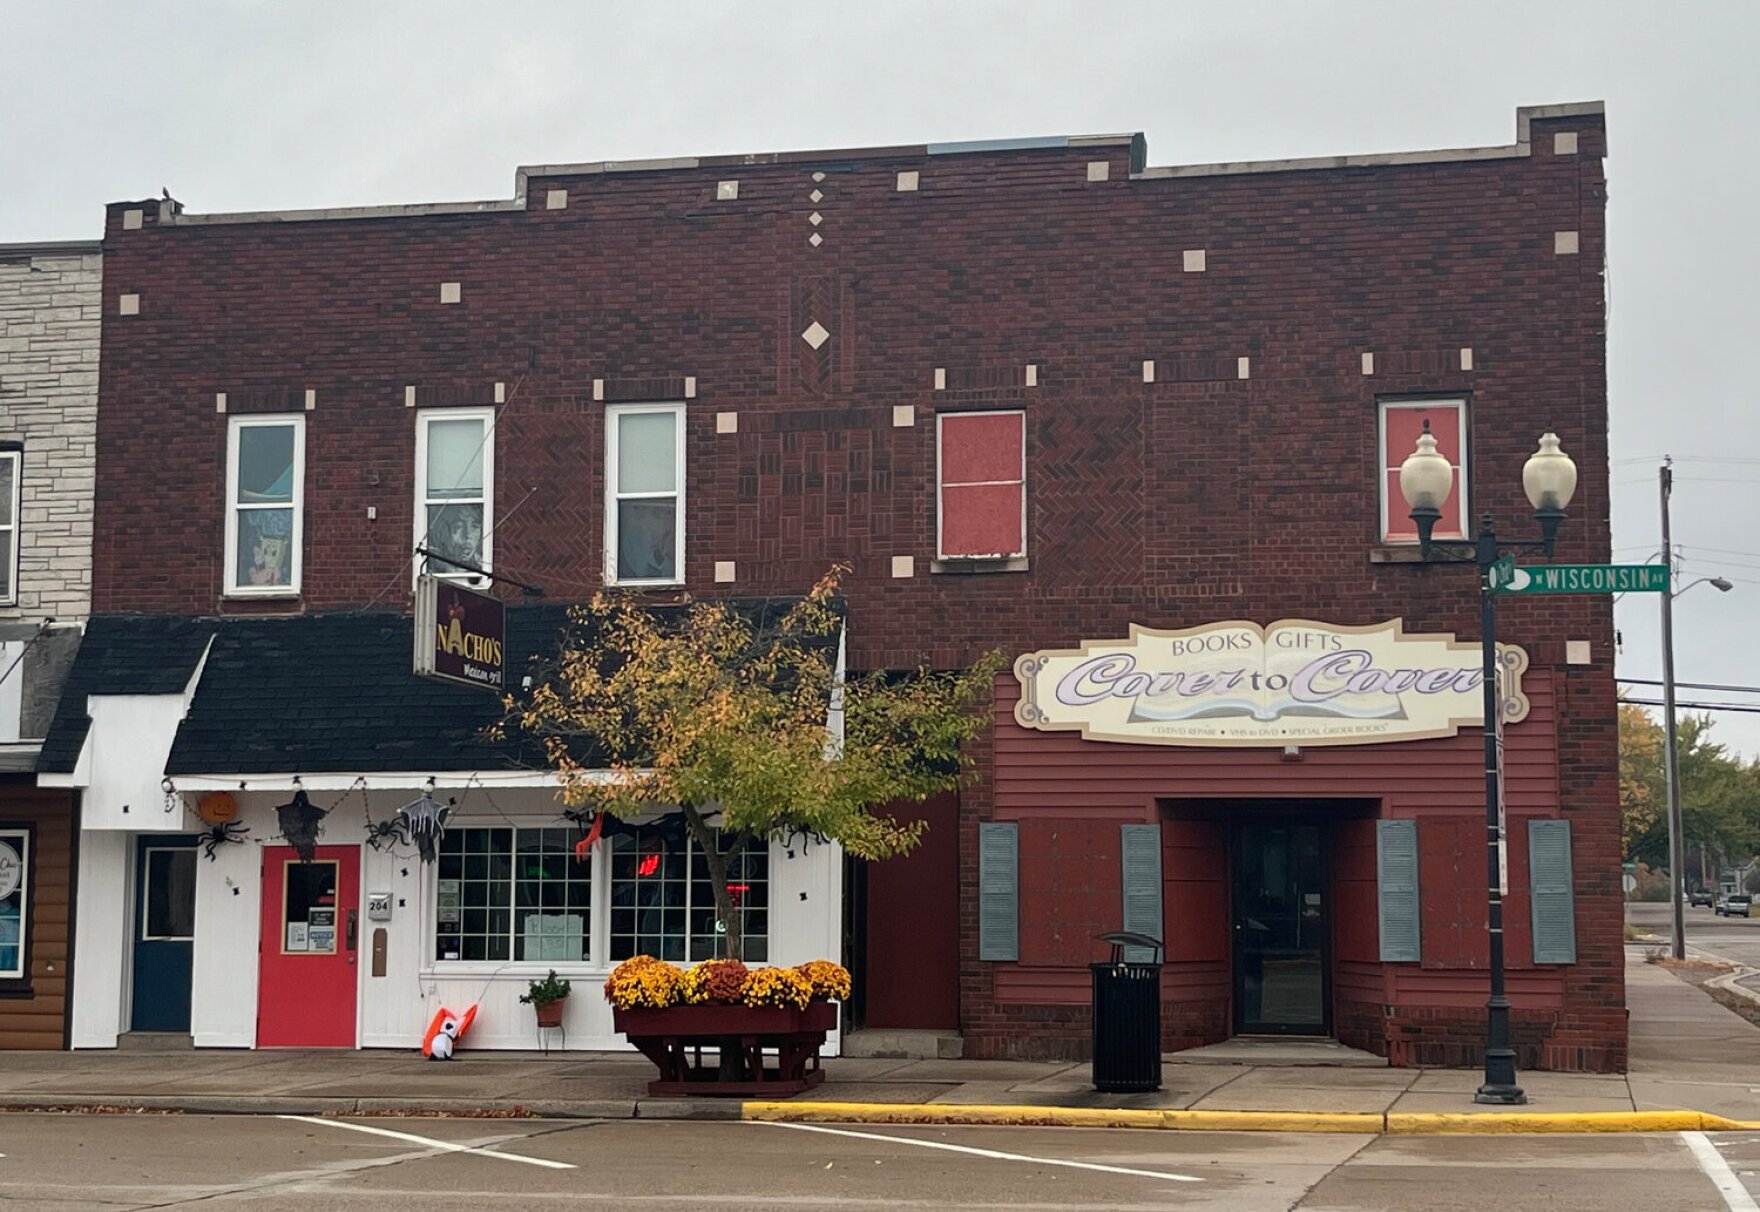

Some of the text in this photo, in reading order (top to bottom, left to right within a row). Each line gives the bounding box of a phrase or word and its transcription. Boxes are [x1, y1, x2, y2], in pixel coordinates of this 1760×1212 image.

[1535, 568, 1664, 589] W WISCONSIN AV
[437, 618, 502, 667] NACHO'S
[1172, 631, 1342, 656] BOOKS GIFTS
[1055, 649, 1485, 706] Cover to Cover
[1258, 727, 1279, 737] DVD
[369, 902, 388, 911] 204
